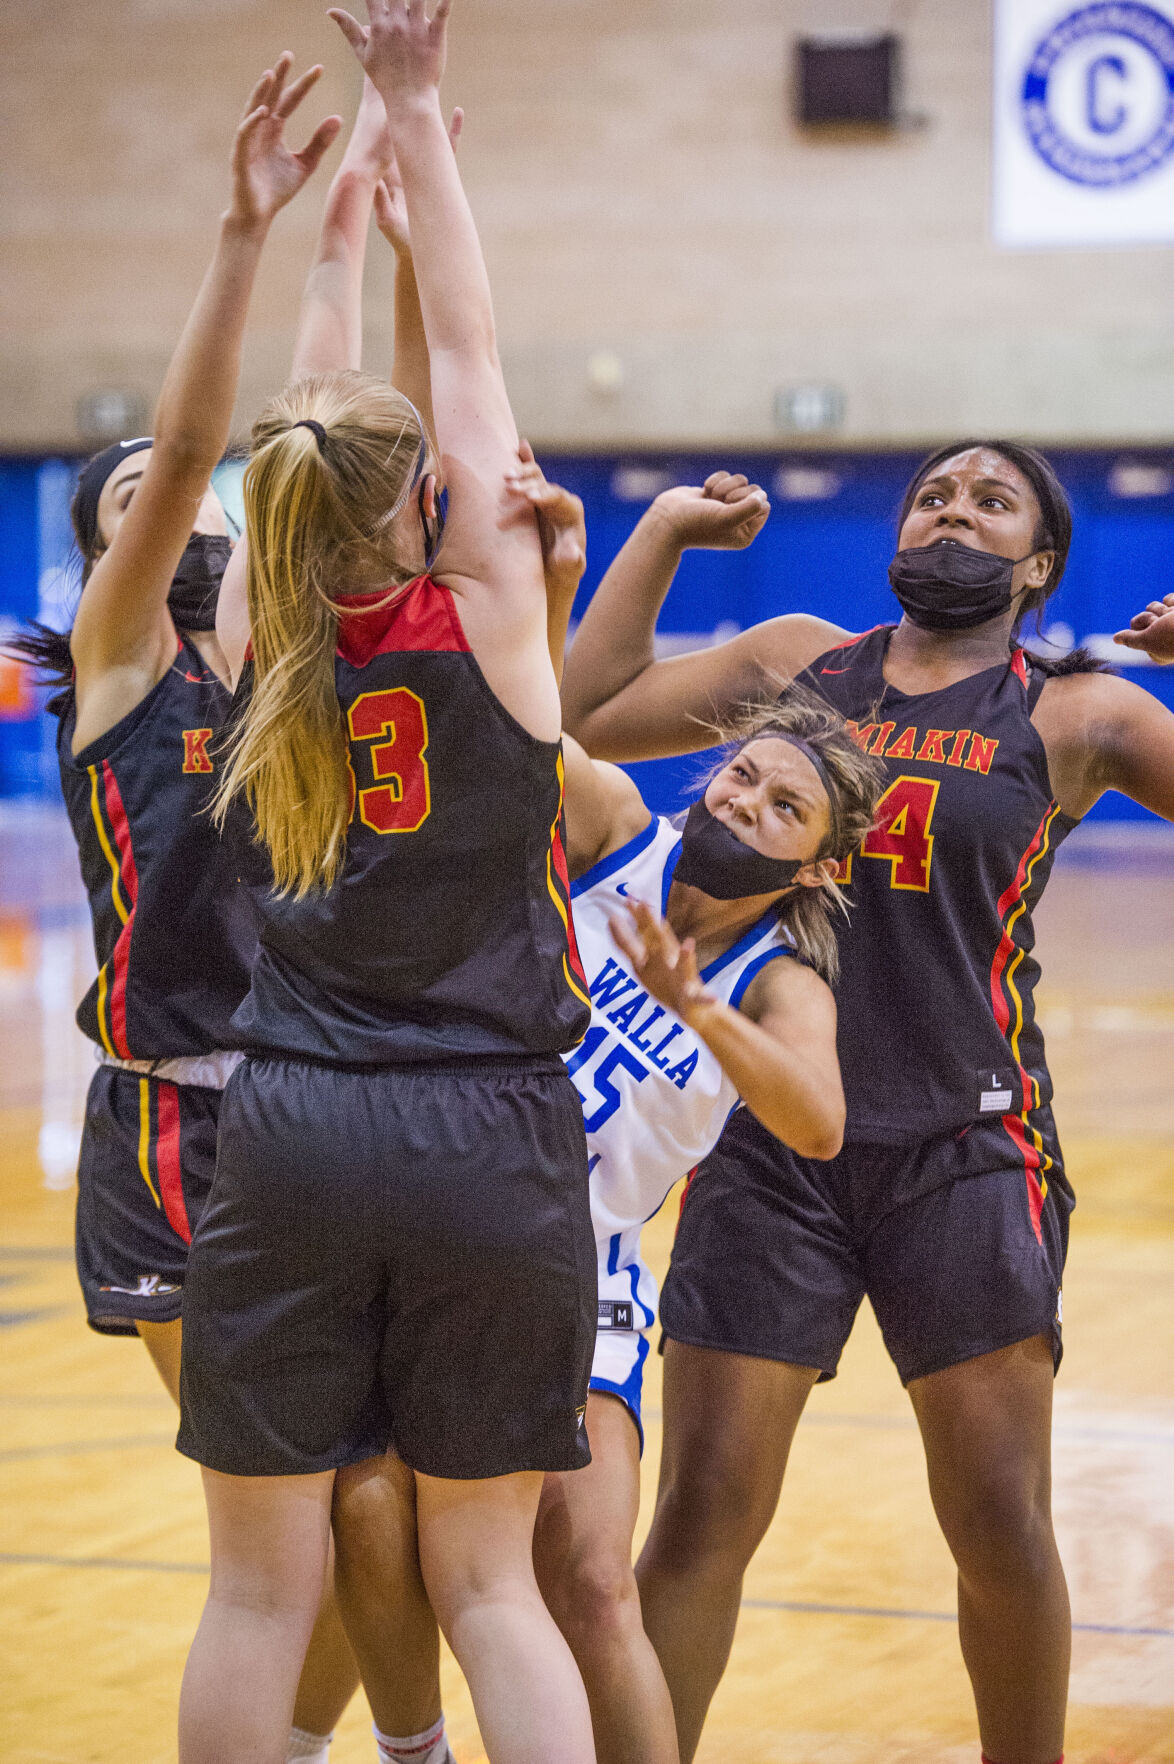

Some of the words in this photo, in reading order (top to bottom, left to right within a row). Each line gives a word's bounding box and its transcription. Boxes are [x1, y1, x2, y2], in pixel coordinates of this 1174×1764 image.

[589, 956, 700, 1090] WALLA
[567, 1026, 650, 1134] 15
[991, 1073, 1002, 1089] L
[618, 1309, 627, 1322] M
